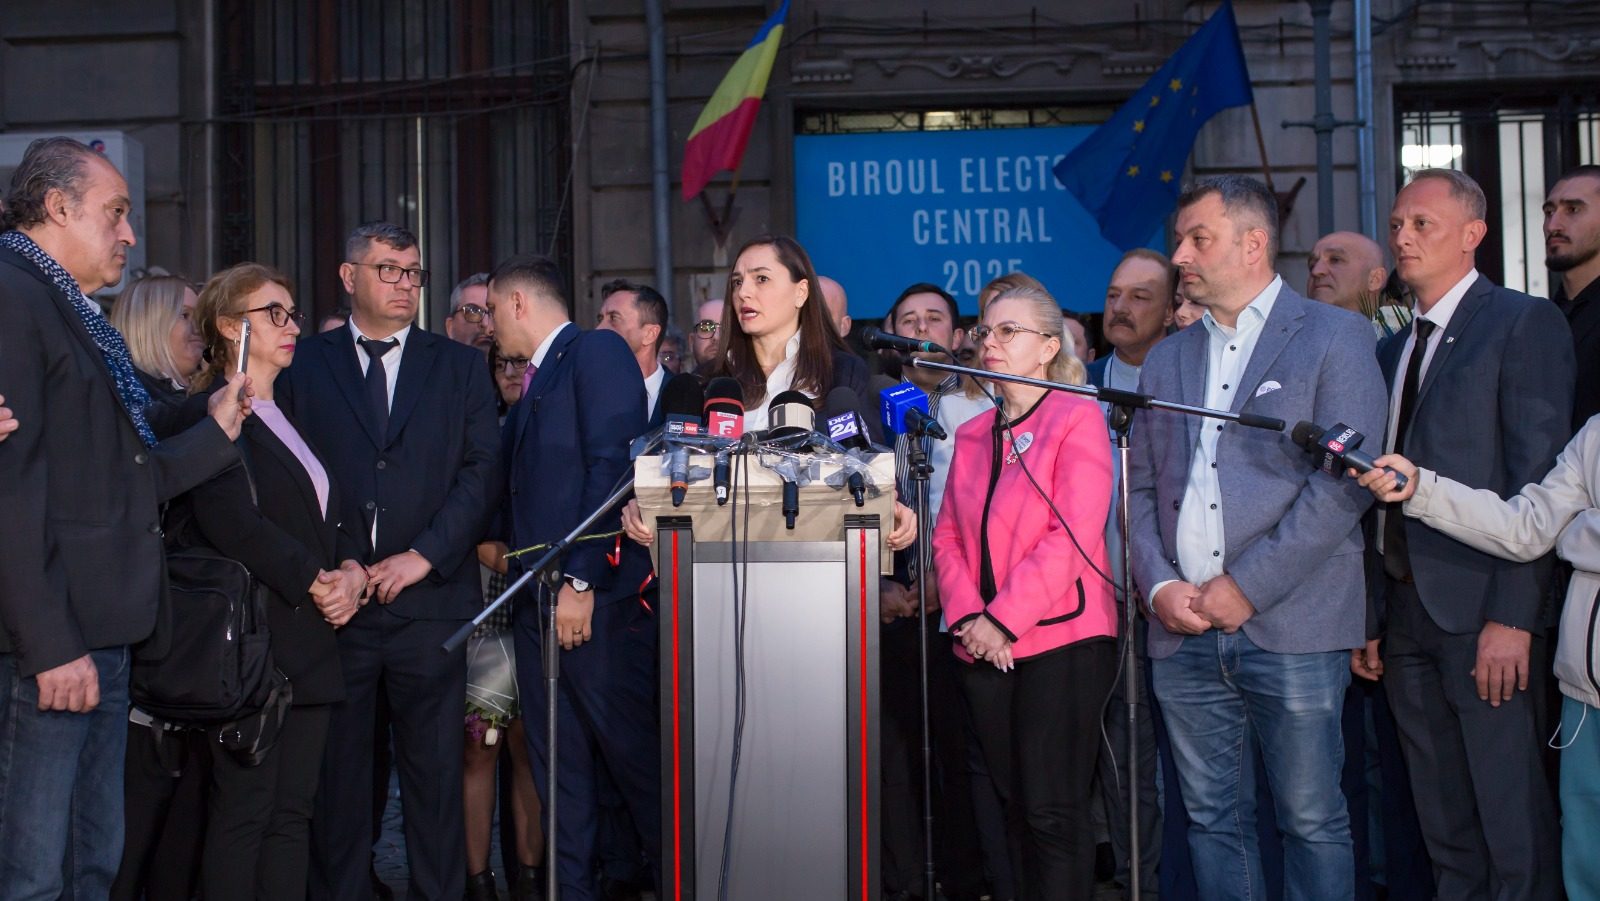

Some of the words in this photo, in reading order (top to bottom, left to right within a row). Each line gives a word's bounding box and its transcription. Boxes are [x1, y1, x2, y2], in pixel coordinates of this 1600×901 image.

[827, 158, 945, 197] BIROUL
[912, 206, 1053, 246] CENTRAL
[828, 413, 854, 426] DIGI
[830, 420, 858, 439] 24
